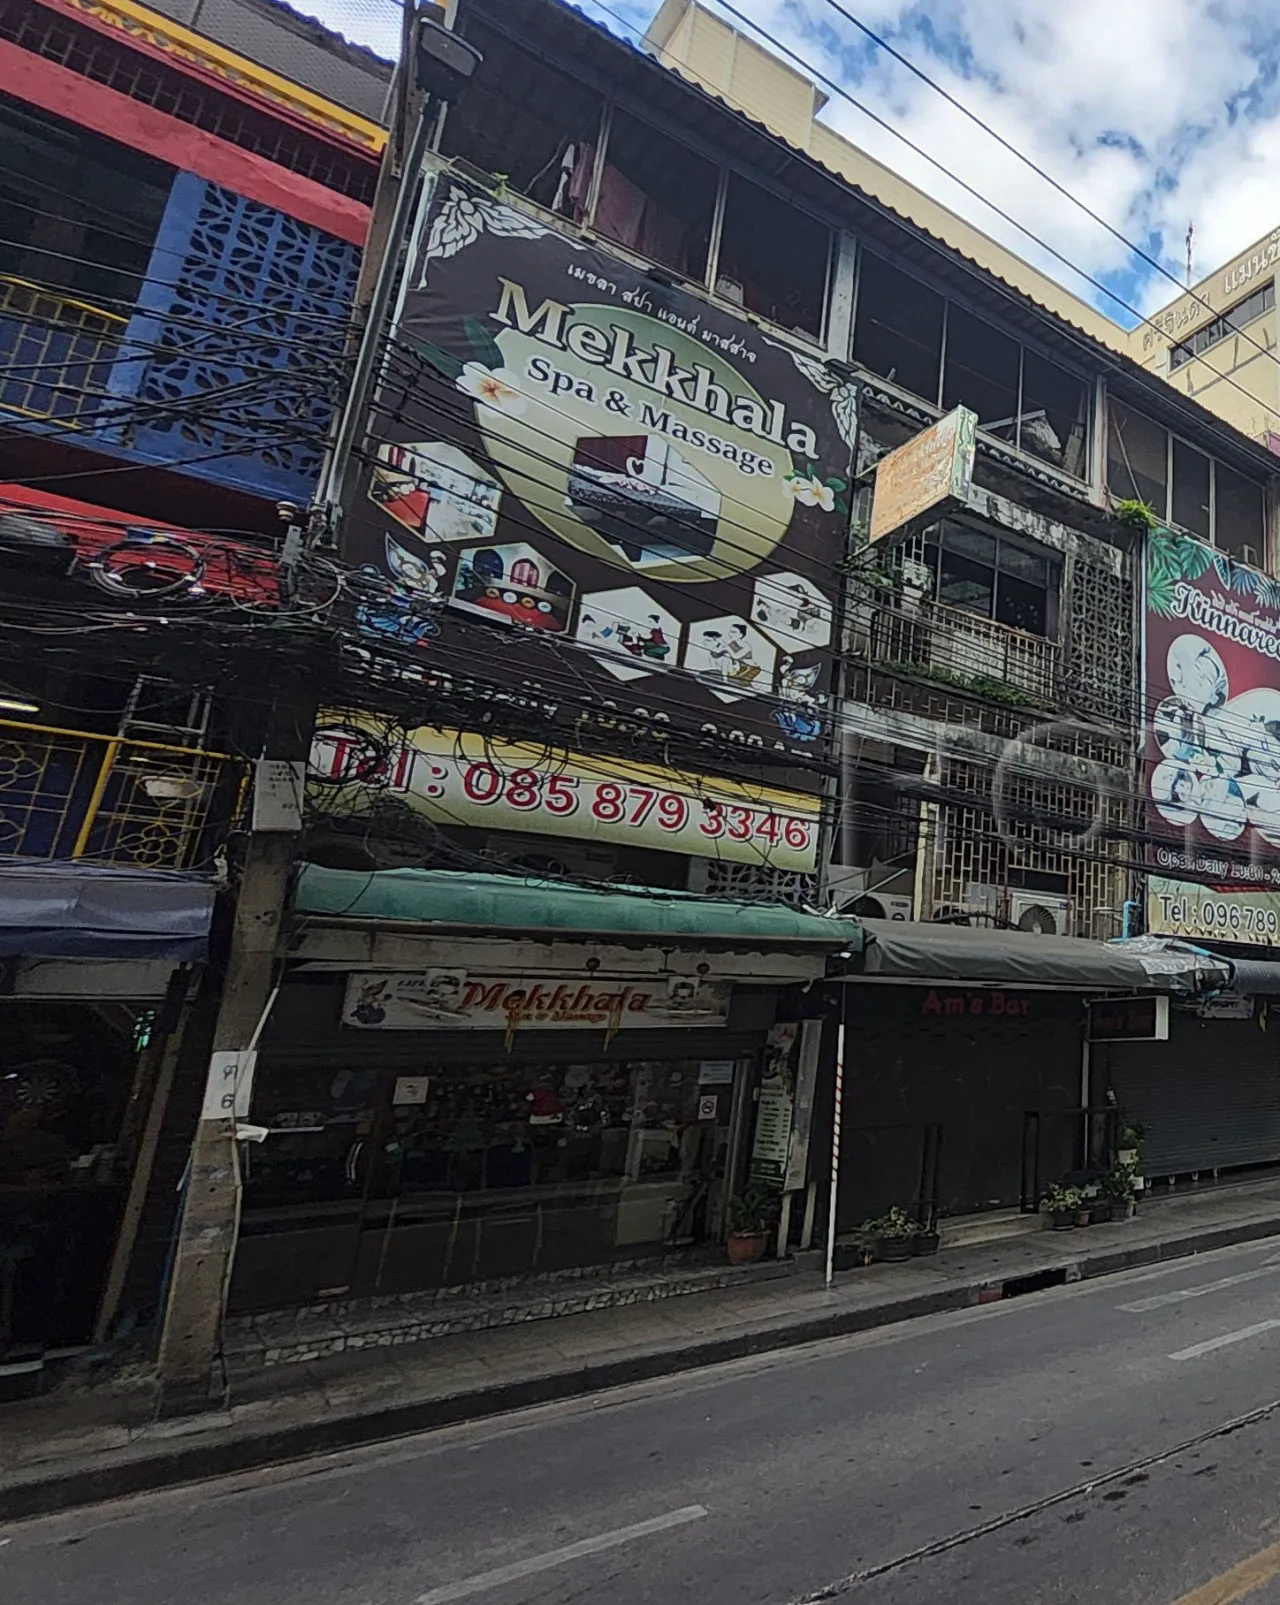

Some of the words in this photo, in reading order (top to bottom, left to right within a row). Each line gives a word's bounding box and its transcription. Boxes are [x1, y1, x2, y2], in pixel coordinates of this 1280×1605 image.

[622, 286, 653, 313] สปา
[489, 277, 821, 462] Mekkhala
[525, 355, 597, 406] Spa
[604, 388, 632, 419] &
[641, 403, 777, 478] Massage
[464, 760, 580, 816] 085
[592, 784, 689, 833] 879
[699, 803, 812, 852] 3346
[1159, 894, 1188, 924] Tel
[1203, 901, 1241, 930] 096
[1243, 907, 1278, 935] 789
[458, 980, 652, 1013] Mekkhala
[988, 991, 1033, 1016] Bar
